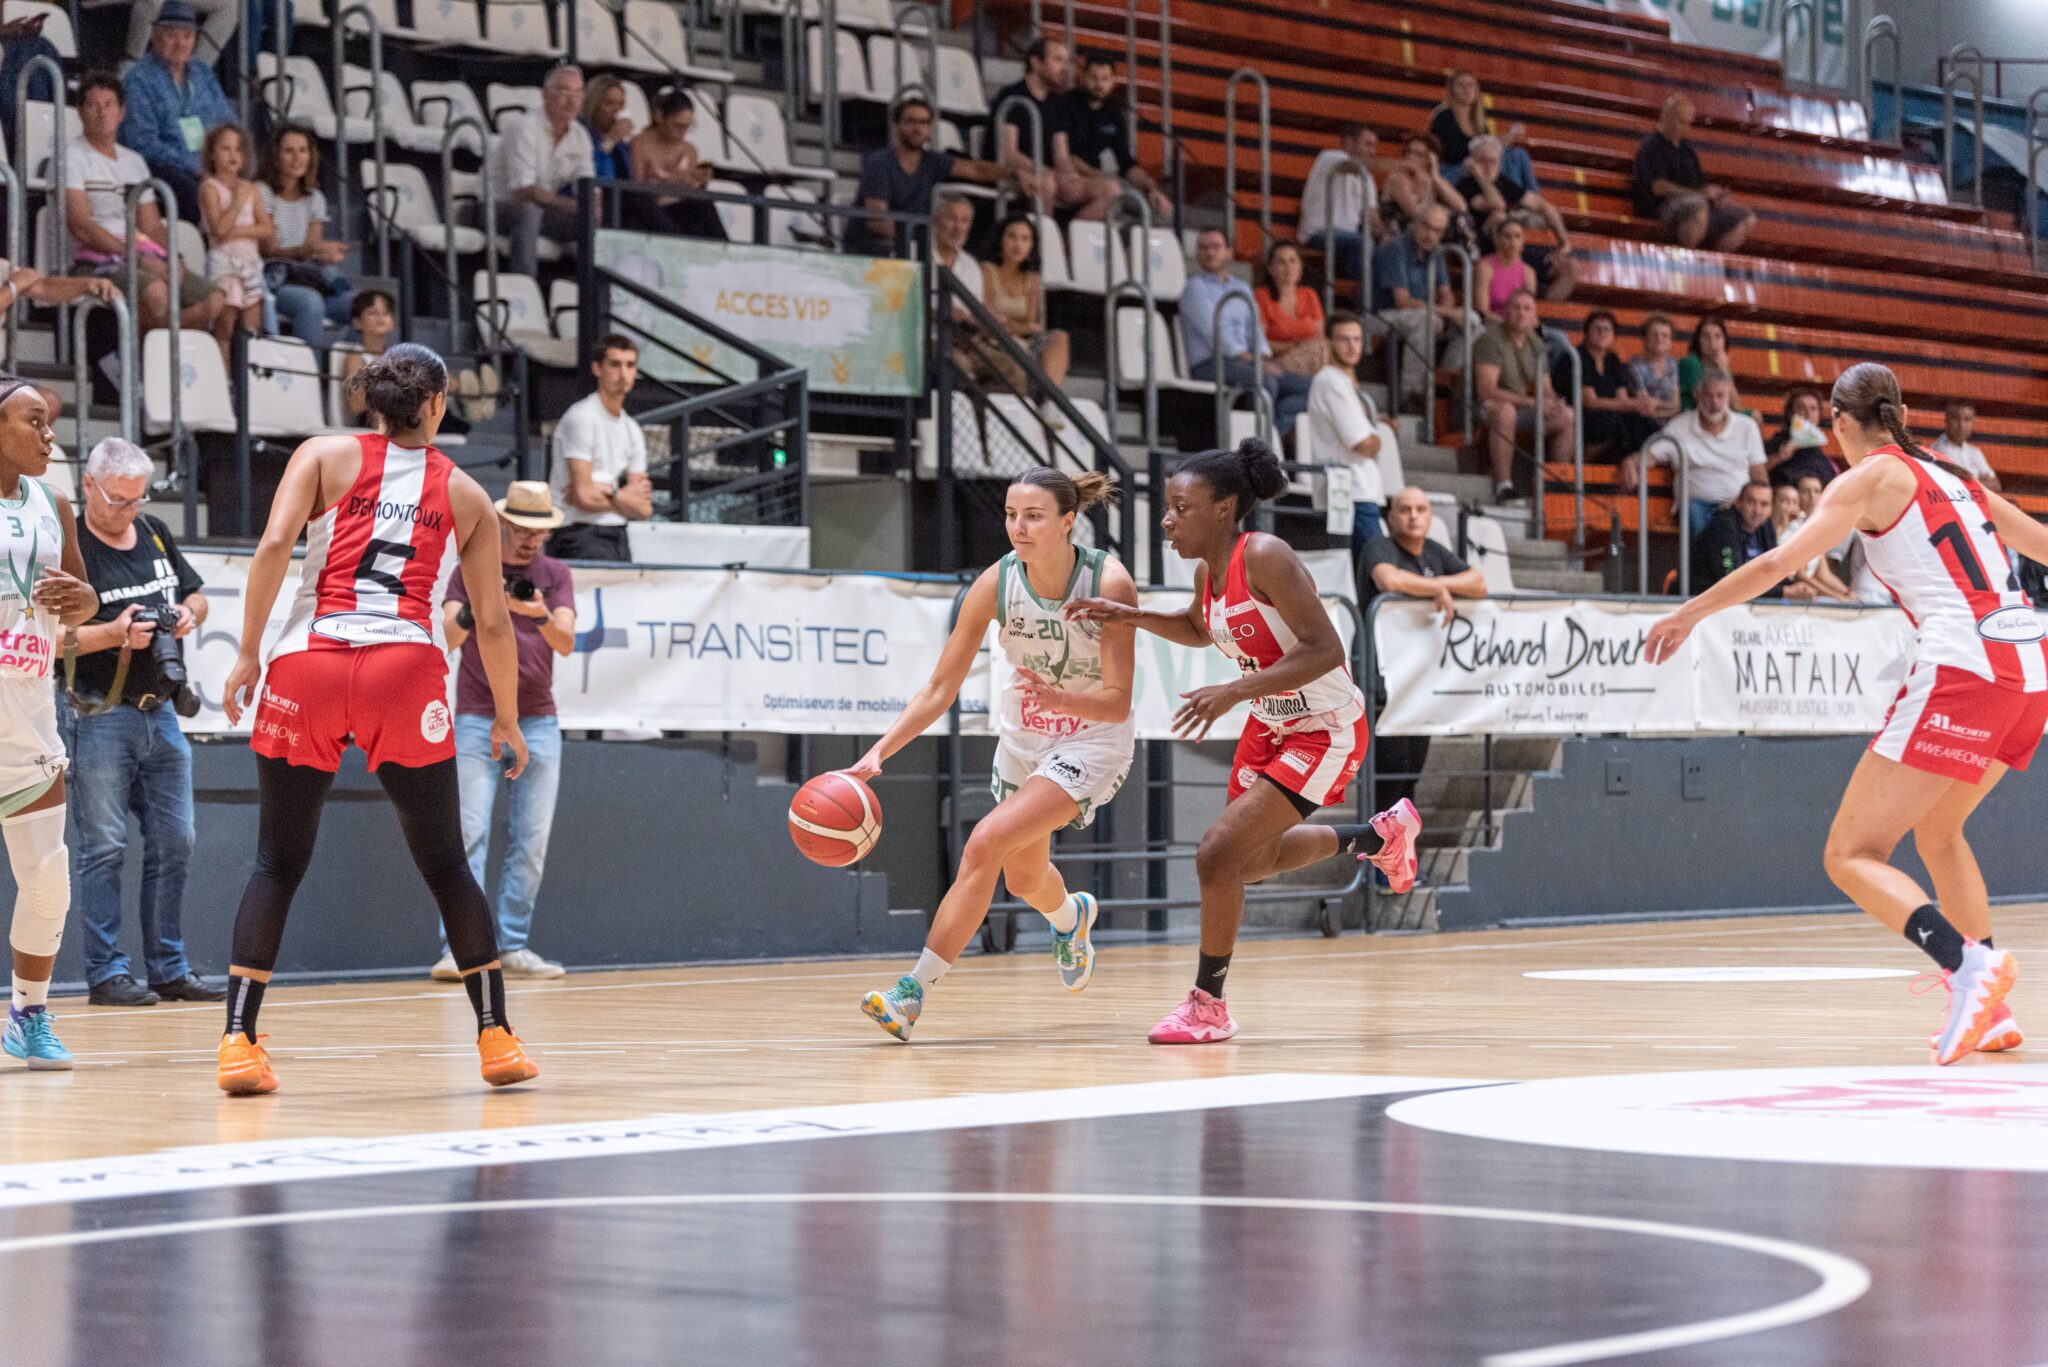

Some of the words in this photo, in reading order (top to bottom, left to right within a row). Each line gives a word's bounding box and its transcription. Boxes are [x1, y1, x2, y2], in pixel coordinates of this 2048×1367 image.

[715, 289, 790, 320] ACCES
[794, 297, 831, 321] VIP
[7, 516, 25, 538] 3
[348, 496, 444, 532] DEMONTOUX
[1035, 618, 1064, 641] 20
[1440, 609, 1547, 672] Richard
[1765, 623, 1814, 647] AXELLE
[1733, 650, 1863, 697] MATAIX
[1484, 681, 1607, 698] AUTOMOBILES
[837, 697, 852, 710] de
[1914, 740, 1990, 770] #WEAREONE
